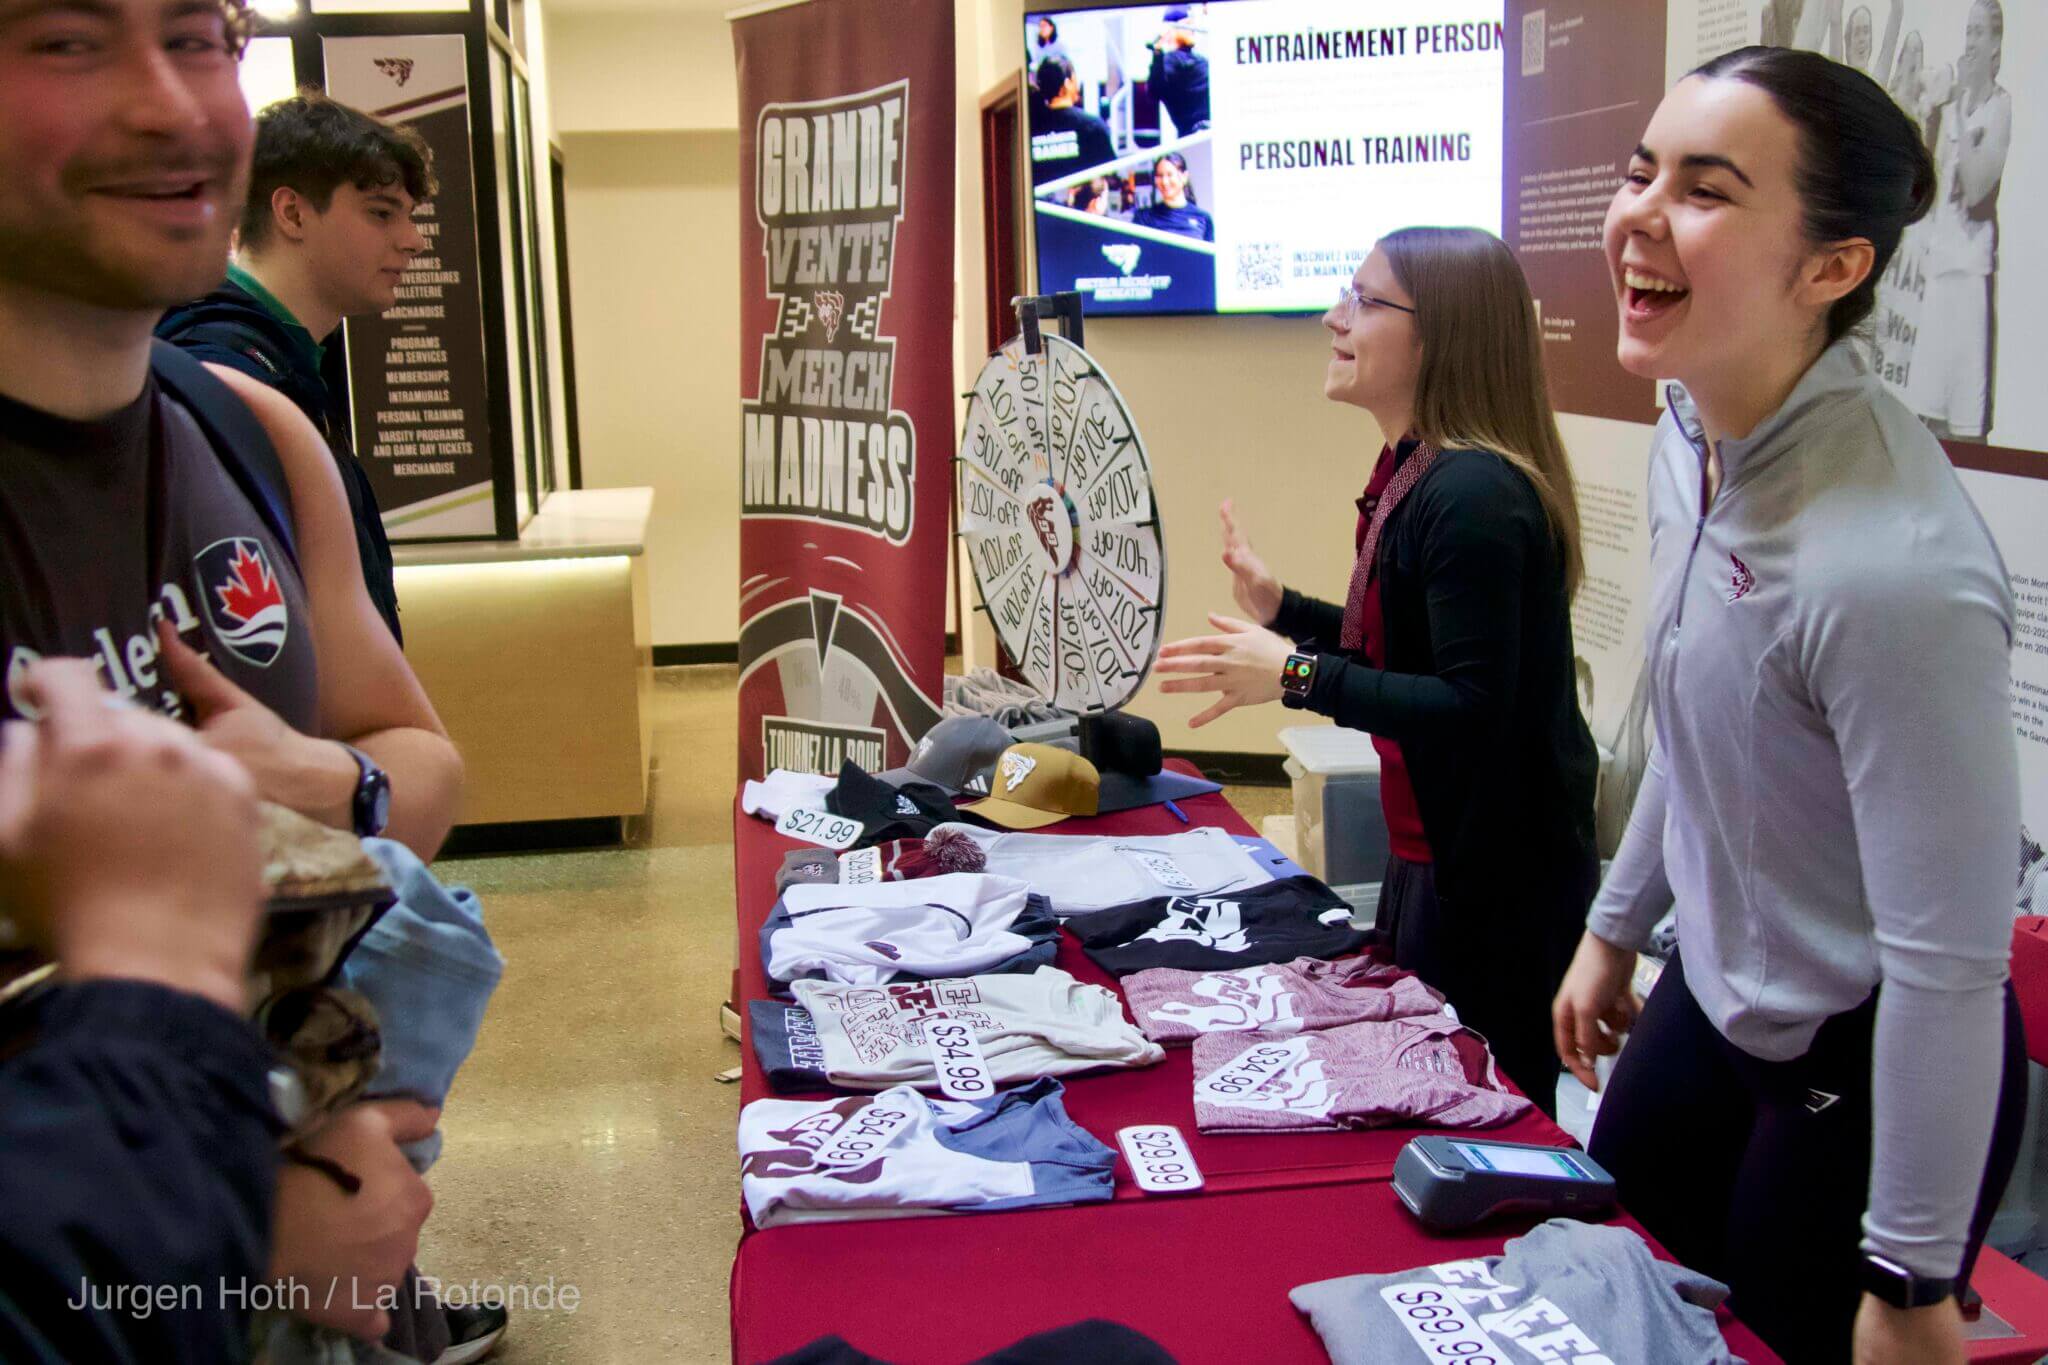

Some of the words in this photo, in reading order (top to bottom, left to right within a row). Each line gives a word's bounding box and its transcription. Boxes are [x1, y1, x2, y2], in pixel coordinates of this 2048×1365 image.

[762, 97, 901, 217] GRANDE
[1240, 138, 1356, 171] PERSONAL
[1363, 132, 1472, 165] TRAINING
[770, 221, 890, 285] VENTE
[402, 270, 460, 284] IVERSITAIRES
[385, 351, 404, 364] AND
[405, 349, 448, 363] SERVICES
[391, 336, 440, 350] PROGRAMS
[385, 369, 450, 384] MEMBERSHIPS
[765, 347, 889, 413] MERCH
[376, 410, 423, 423] PERSONAL
[423, 408, 464, 422] TRAINING
[388, 389, 450, 404] INTRAMURALS
[373, 444, 392, 457] AND
[392, 443, 418, 457] GAME
[419, 443, 437, 456] DAY
[437, 441, 473, 455] TICKETS
[378, 430, 415, 443] VARSITY
[416, 428, 465, 441] PROGRAMS
[393, 461, 456, 476] MERCHANDISE
[744, 412, 908, 532] MADNESS
[769, 728, 821, 774] TOURNEZ
[824, 736, 841, 776] LA
[785, 809, 856, 844] $21.99
[933, 1024, 985, 1093] $34.99
[1208, 1047, 1292, 1094] $34.99
[827, 1107, 908, 1163] $54.99
[1132, 1129, 1189, 1185] $29.99
[1396, 1290, 1497, 1365] $69.99
